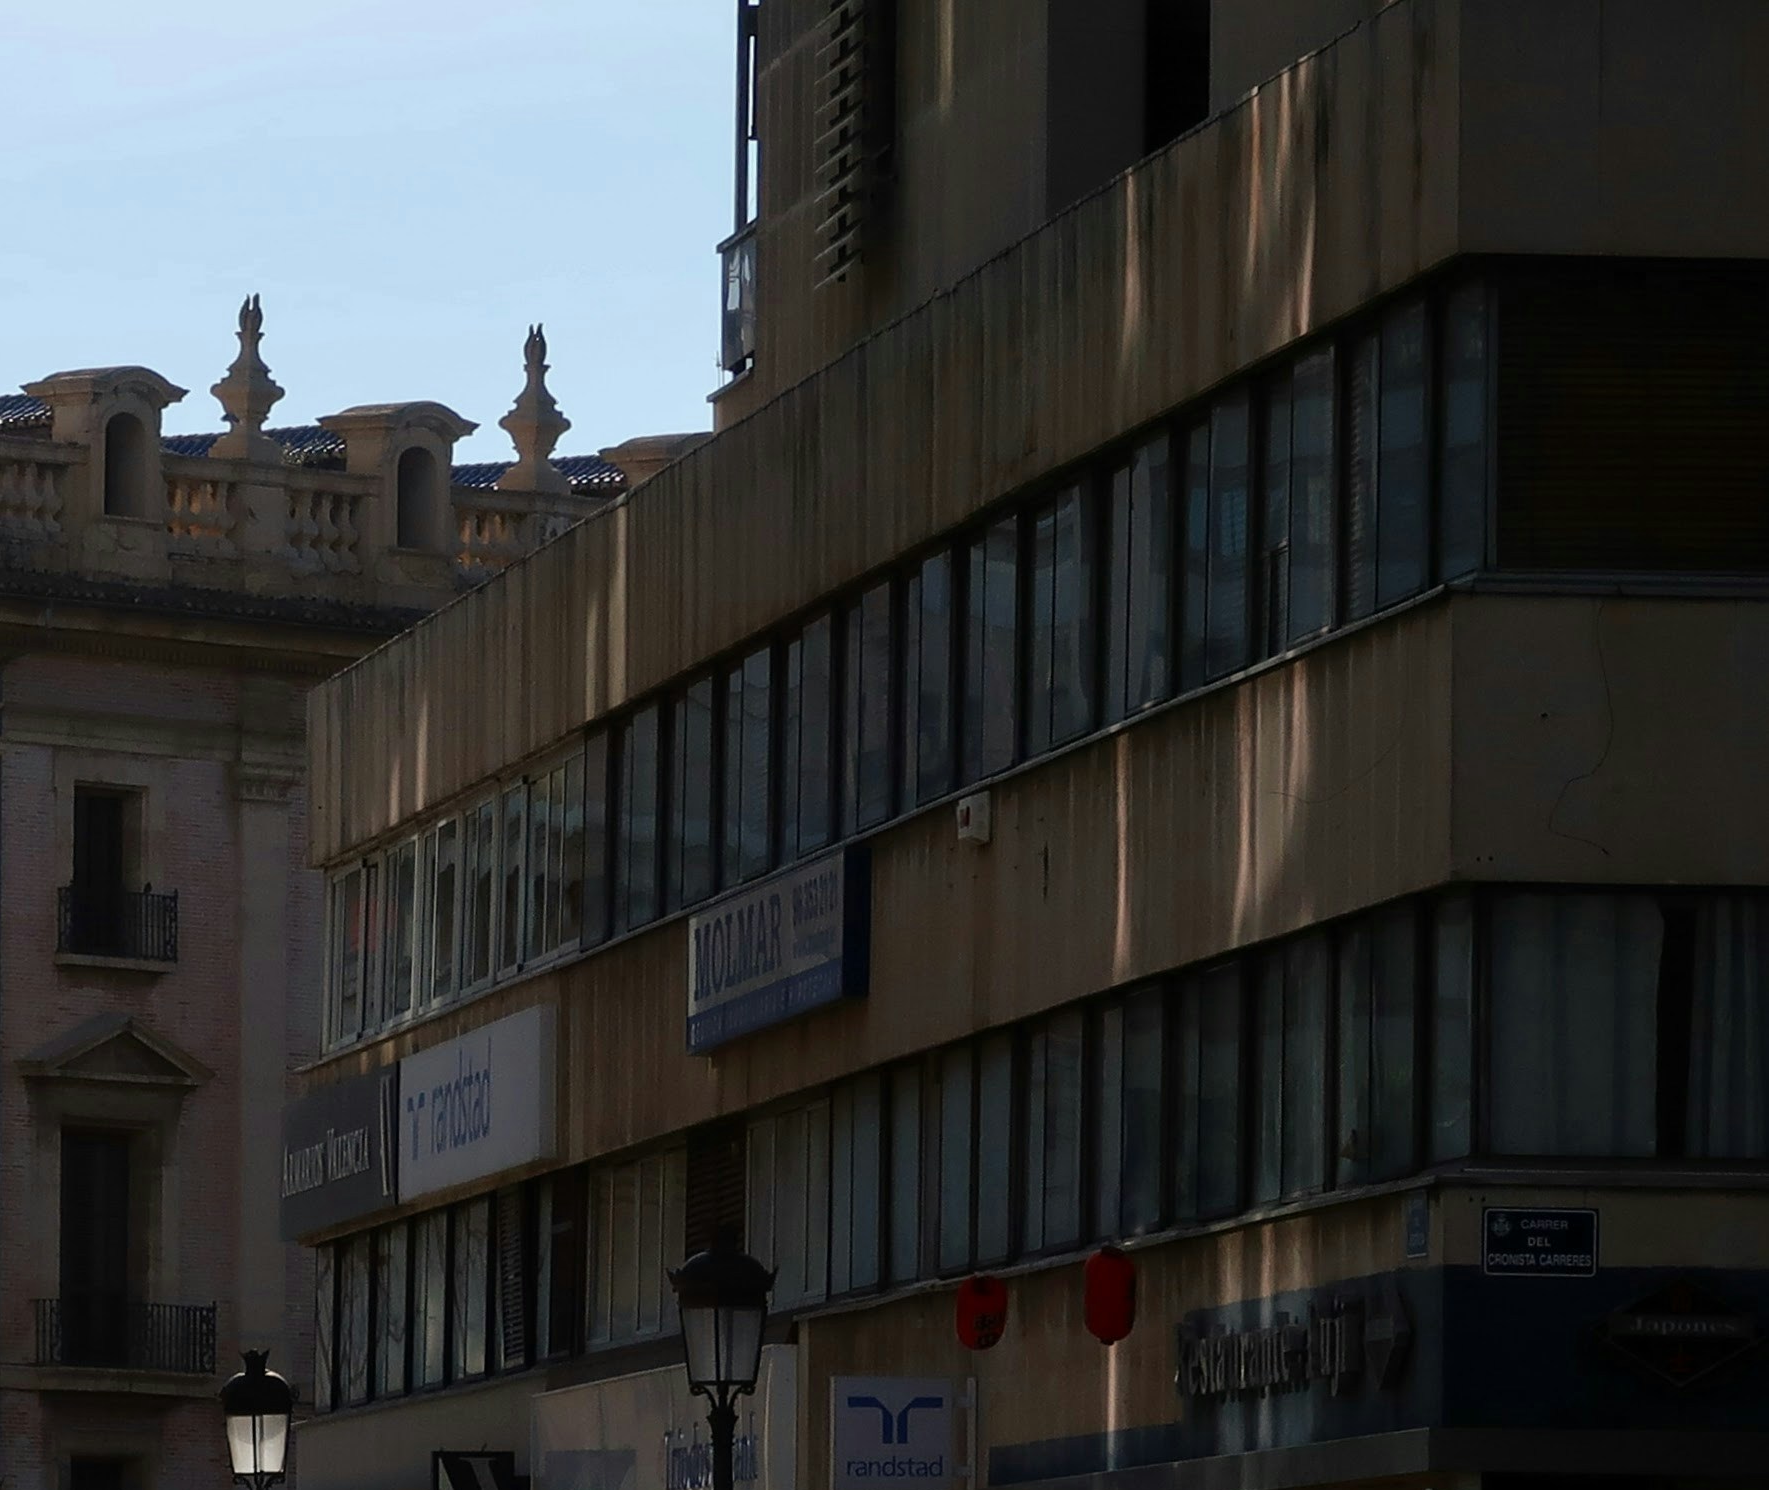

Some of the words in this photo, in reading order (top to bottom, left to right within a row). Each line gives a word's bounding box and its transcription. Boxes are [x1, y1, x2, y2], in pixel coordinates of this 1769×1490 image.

[695, 893, 783, 1001] MOLMAR
[432, 1036, 491, 1154] randstad
[1519, 1218, 1570, 1231] CARRER
[1526, 1236, 1552, 1247] DEL
[1487, 1252, 1537, 1266] CRONISTA
[1538, 1253, 1593, 1267] CARRERES
[846, 1455, 944, 1478] randstad
